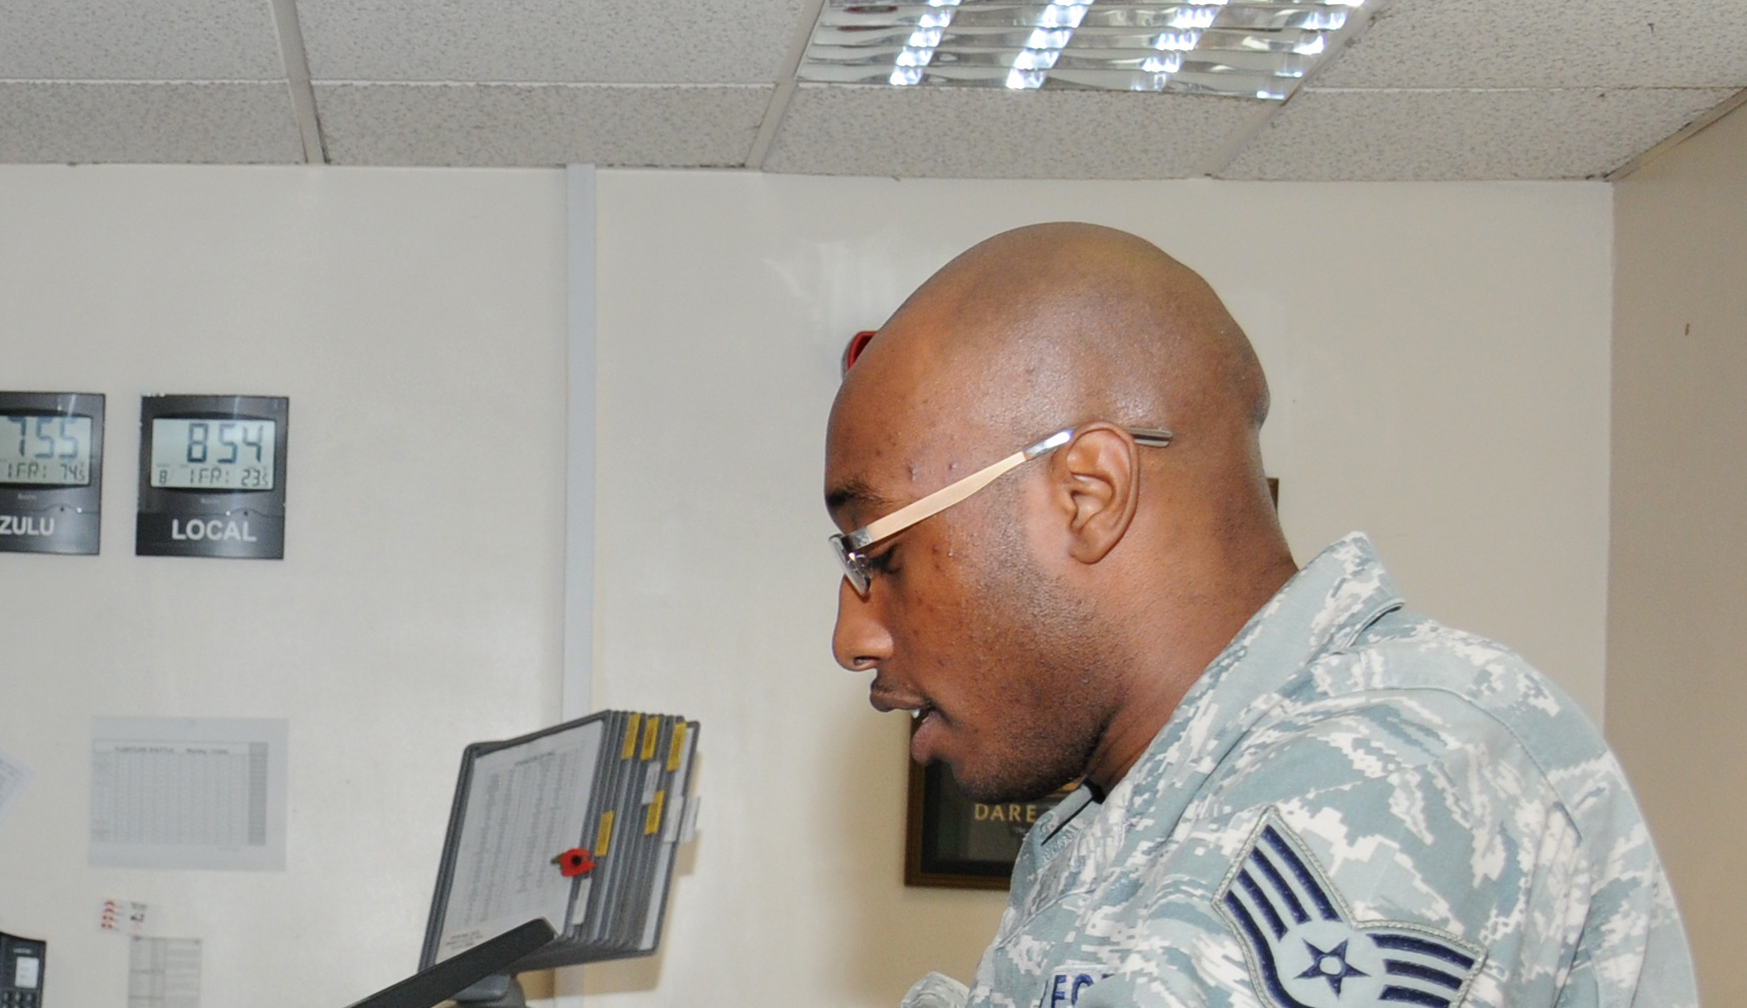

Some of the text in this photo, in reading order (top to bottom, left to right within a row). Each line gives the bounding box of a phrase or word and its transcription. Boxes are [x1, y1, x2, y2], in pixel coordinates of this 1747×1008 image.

[186, 422, 264, 464] 854
[171, 518, 258, 543] LOCAL
[974, 803, 1038, 823] DARE
